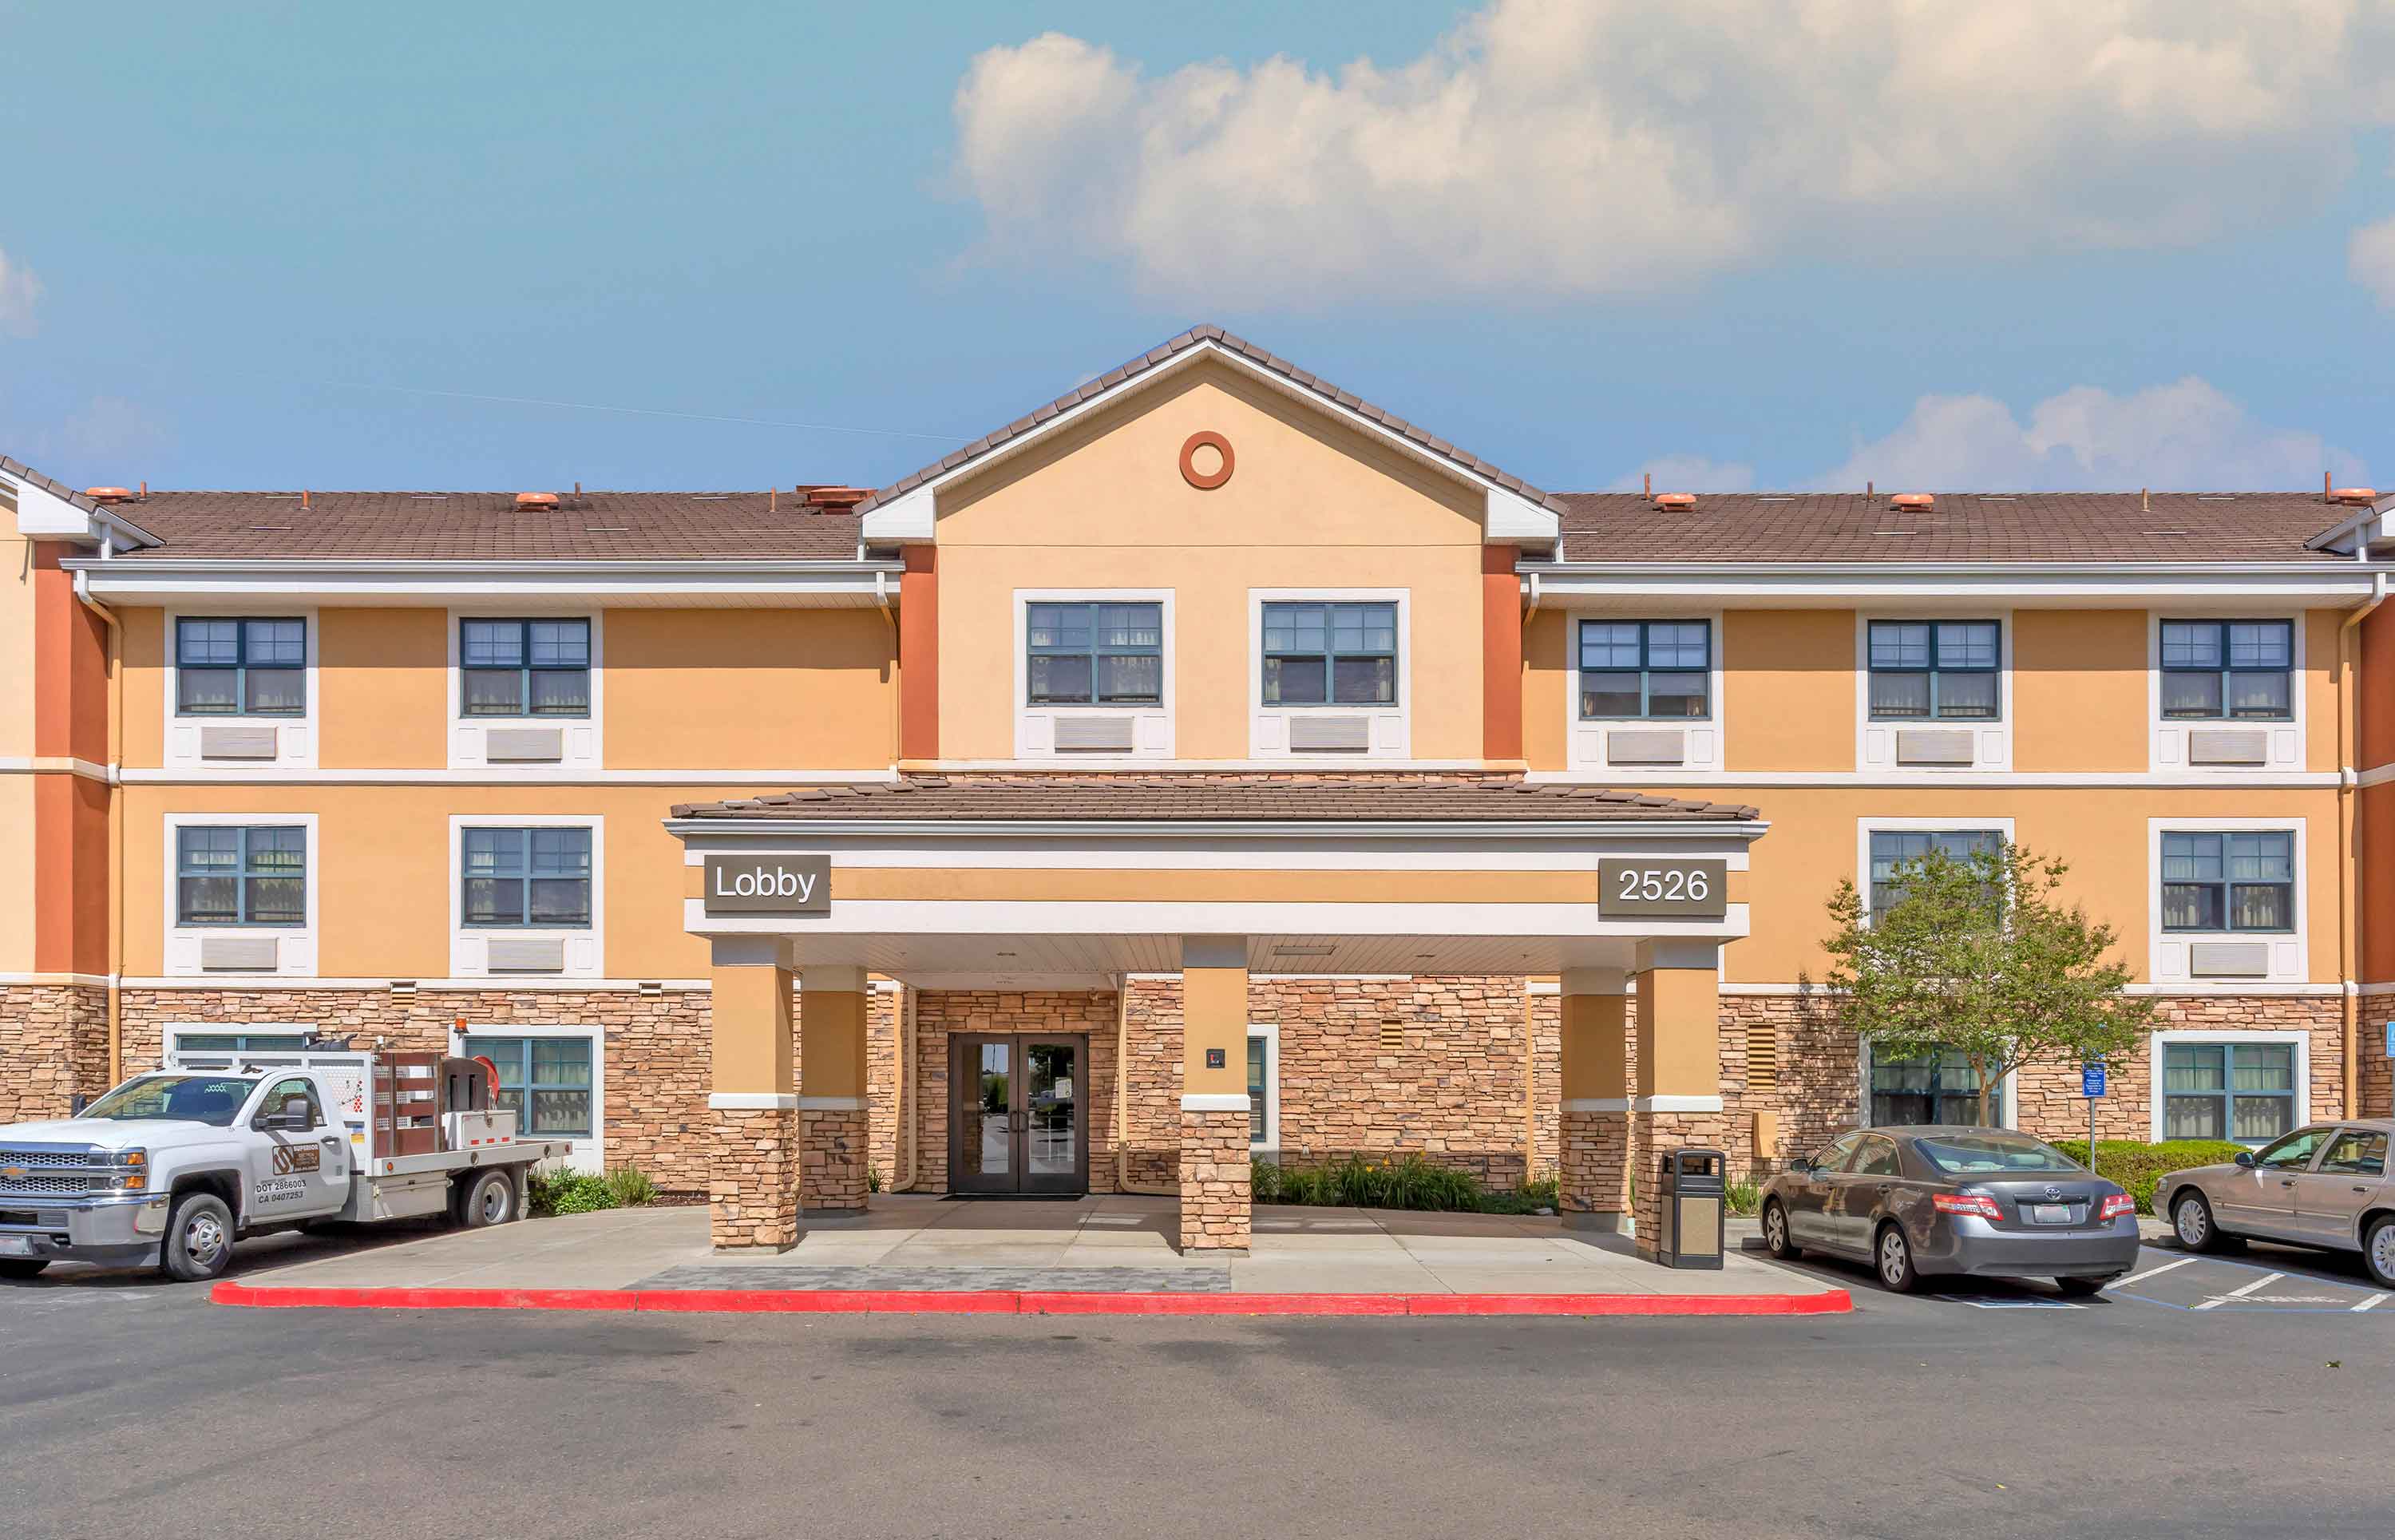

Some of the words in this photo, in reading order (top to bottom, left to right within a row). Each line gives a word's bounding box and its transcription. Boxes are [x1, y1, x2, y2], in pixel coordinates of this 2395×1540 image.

[716, 866, 817, 904] Lobby
[1619, 870, 1708, 901] 2526
[255, 1183, 272, 1193] DOT
[275, 1180, 307, 1190] 2866003
[271, 1191, 303, 1202] 0407253
